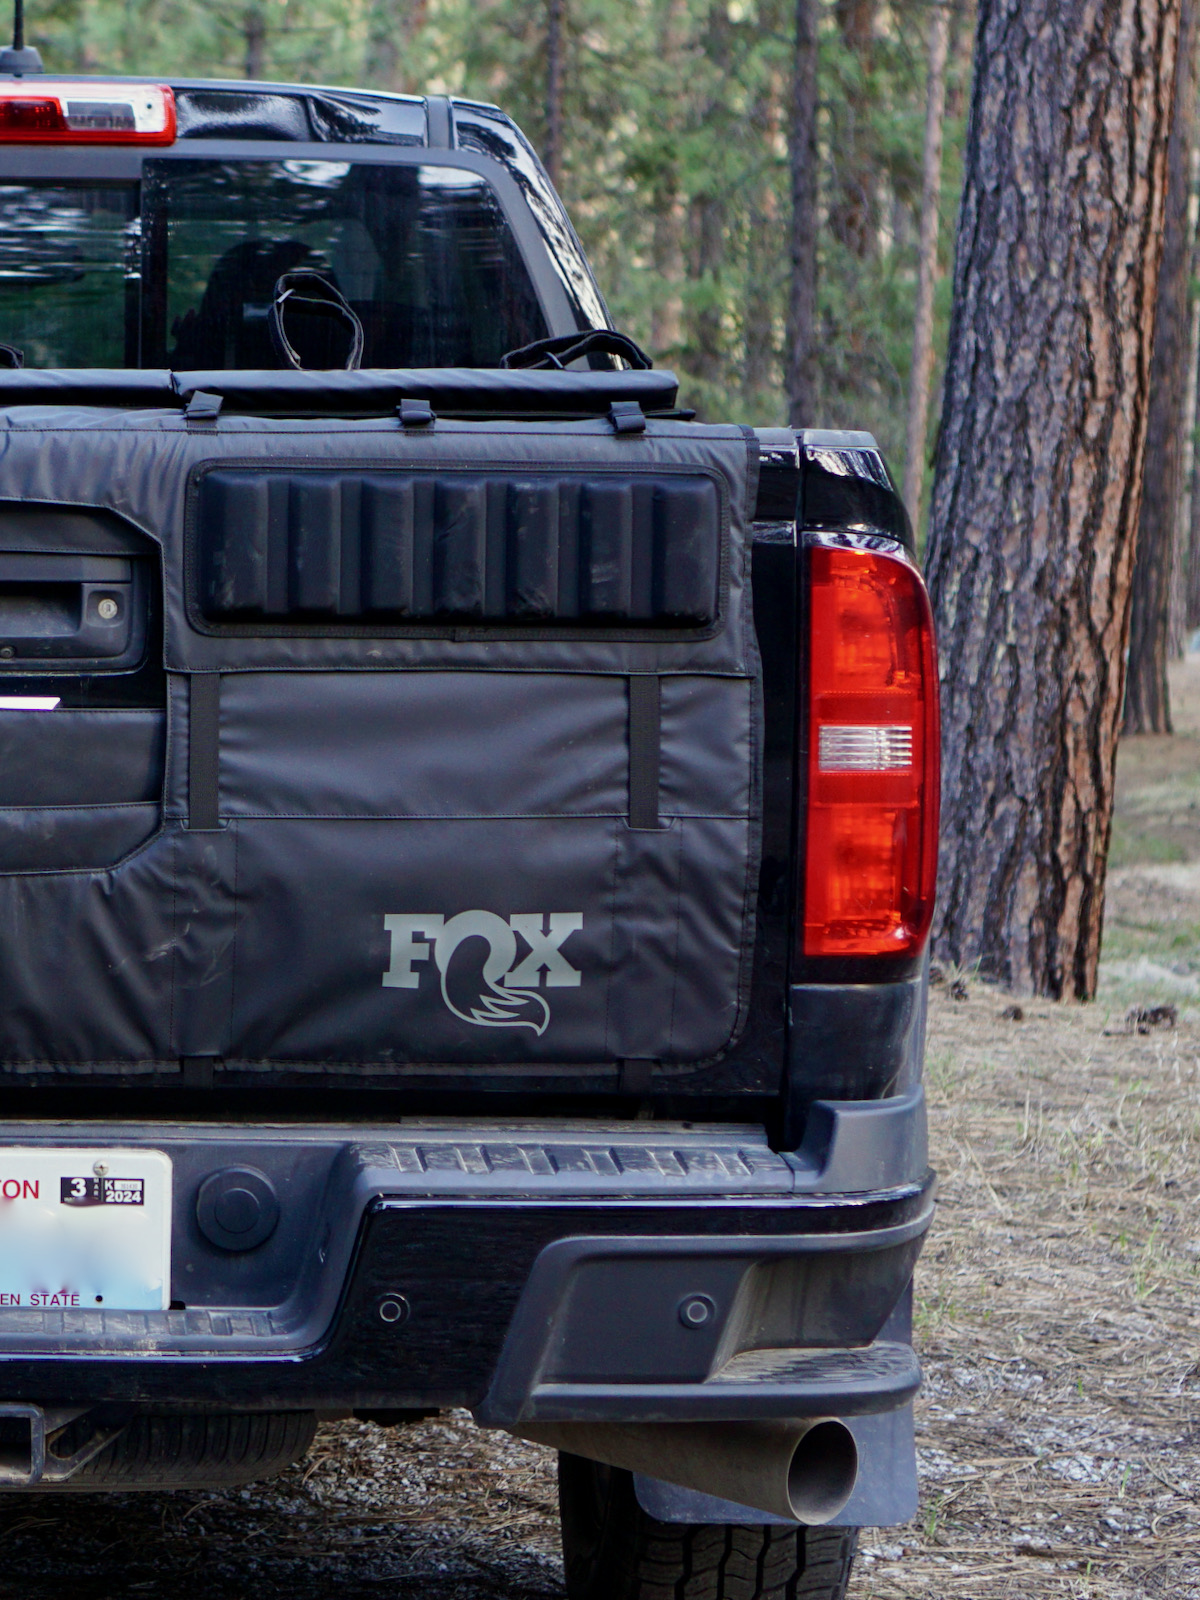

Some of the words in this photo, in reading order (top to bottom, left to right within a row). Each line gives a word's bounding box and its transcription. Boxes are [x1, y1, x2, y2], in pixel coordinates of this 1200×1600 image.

[382, 909, 583, 1036] FOX
[70, 1178, 87, 1197] 3
[104, 1180, 113, 1190] K
[105, 1191, 142, 1203] 2024
[30, 1294, 80, 1306] STATE
